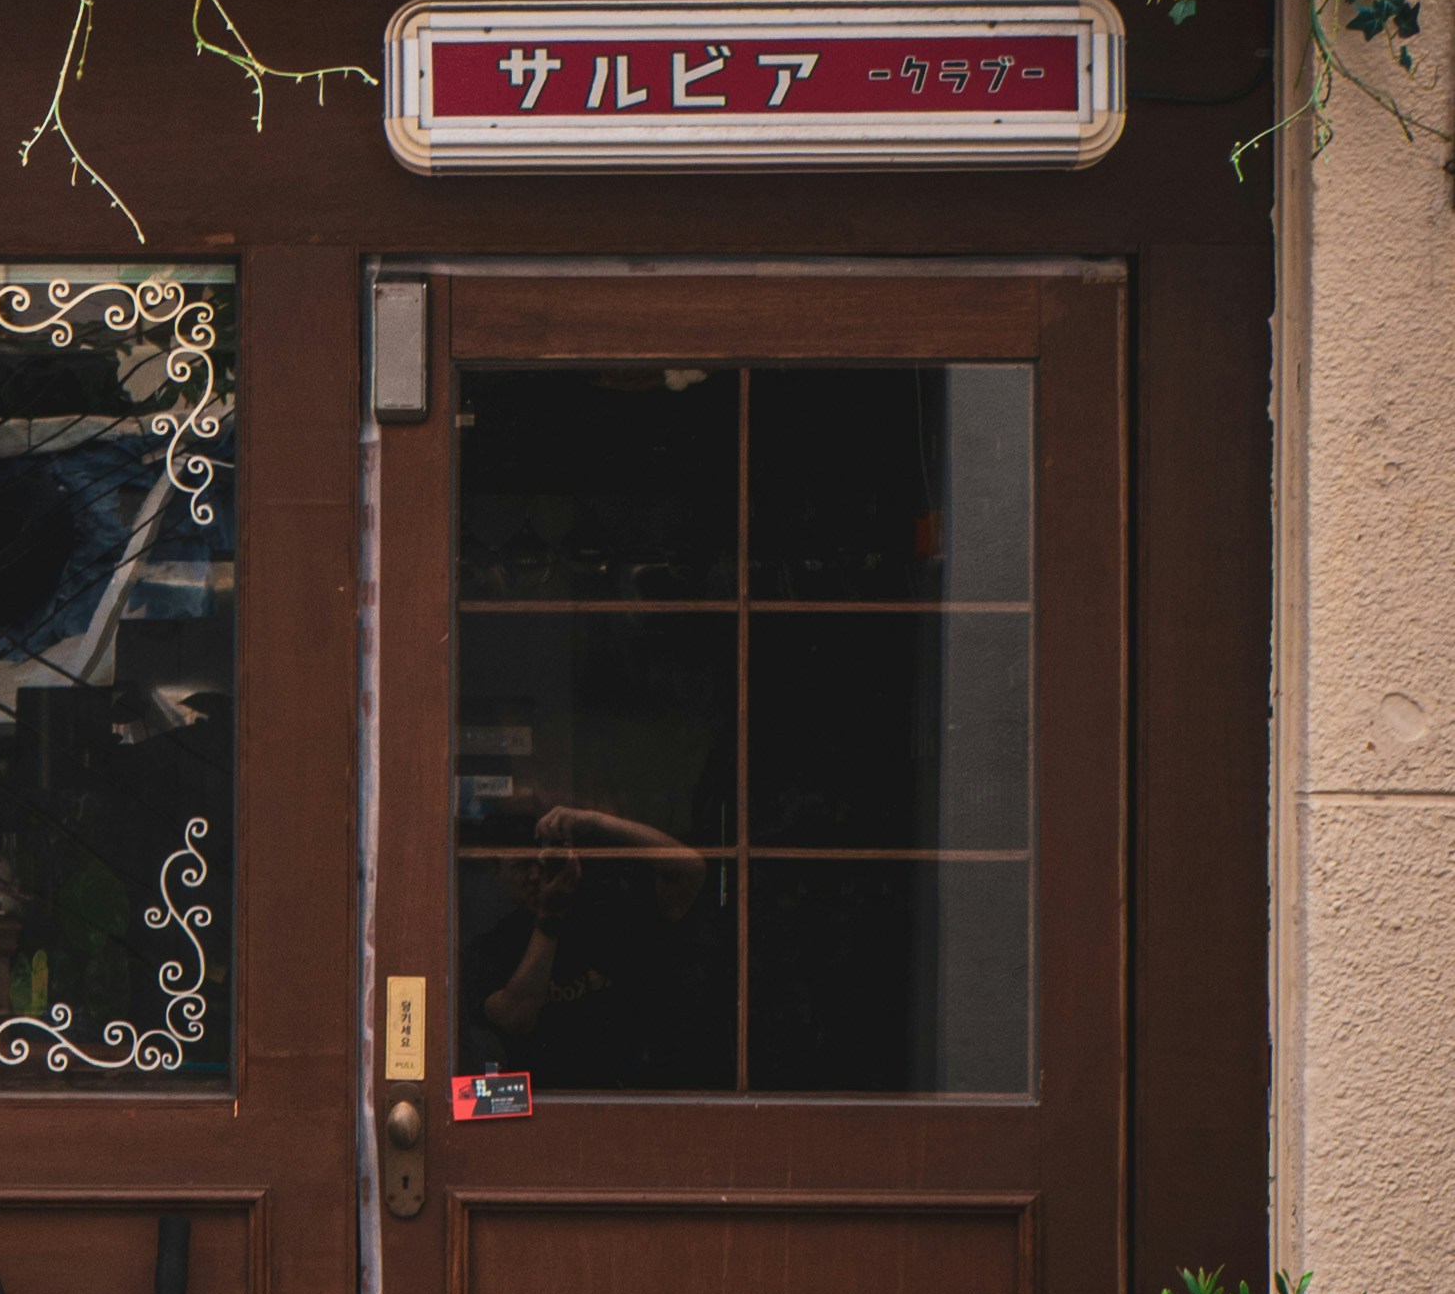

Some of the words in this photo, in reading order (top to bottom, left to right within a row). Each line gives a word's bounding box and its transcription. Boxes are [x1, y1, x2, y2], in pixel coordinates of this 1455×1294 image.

[499, 45, 819, 109] サルビア
[401, 1000, 412, 1047] 당기세요
[395, 1062, 415, 1070] PULL
